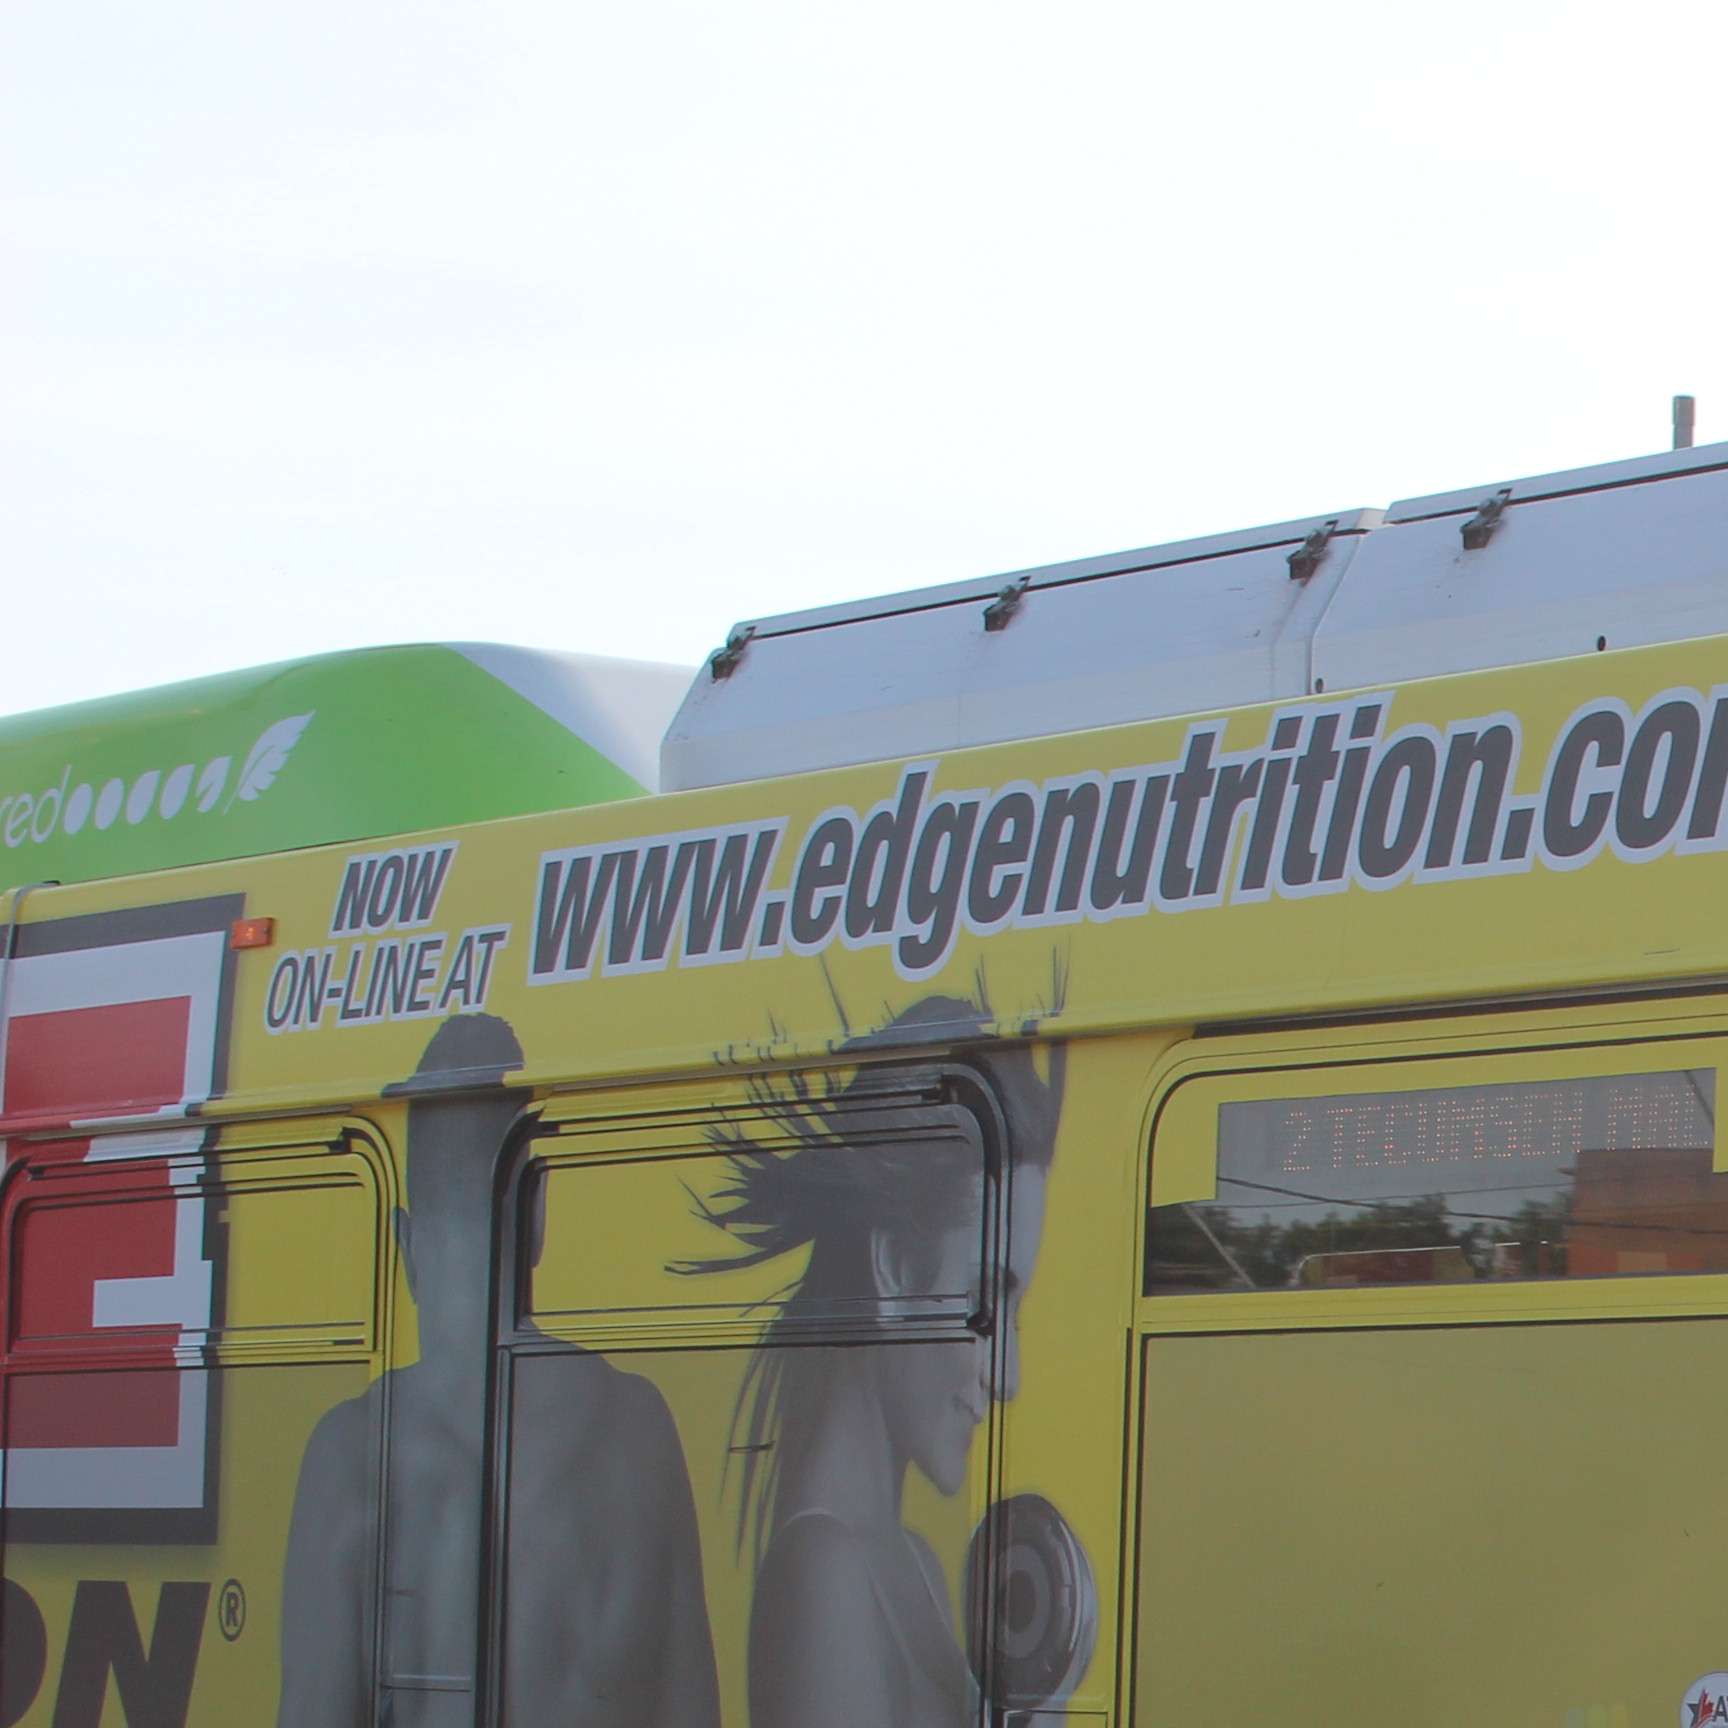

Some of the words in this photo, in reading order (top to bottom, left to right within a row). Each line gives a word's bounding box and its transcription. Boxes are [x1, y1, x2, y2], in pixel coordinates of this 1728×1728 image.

[331, 847, 454, 931] NOW
[266, 938, 444, 1029] ON-LINE
[437, 930, 508, 1010] AT
[1326, 1090, 1583, 1170] TECUMSEH
